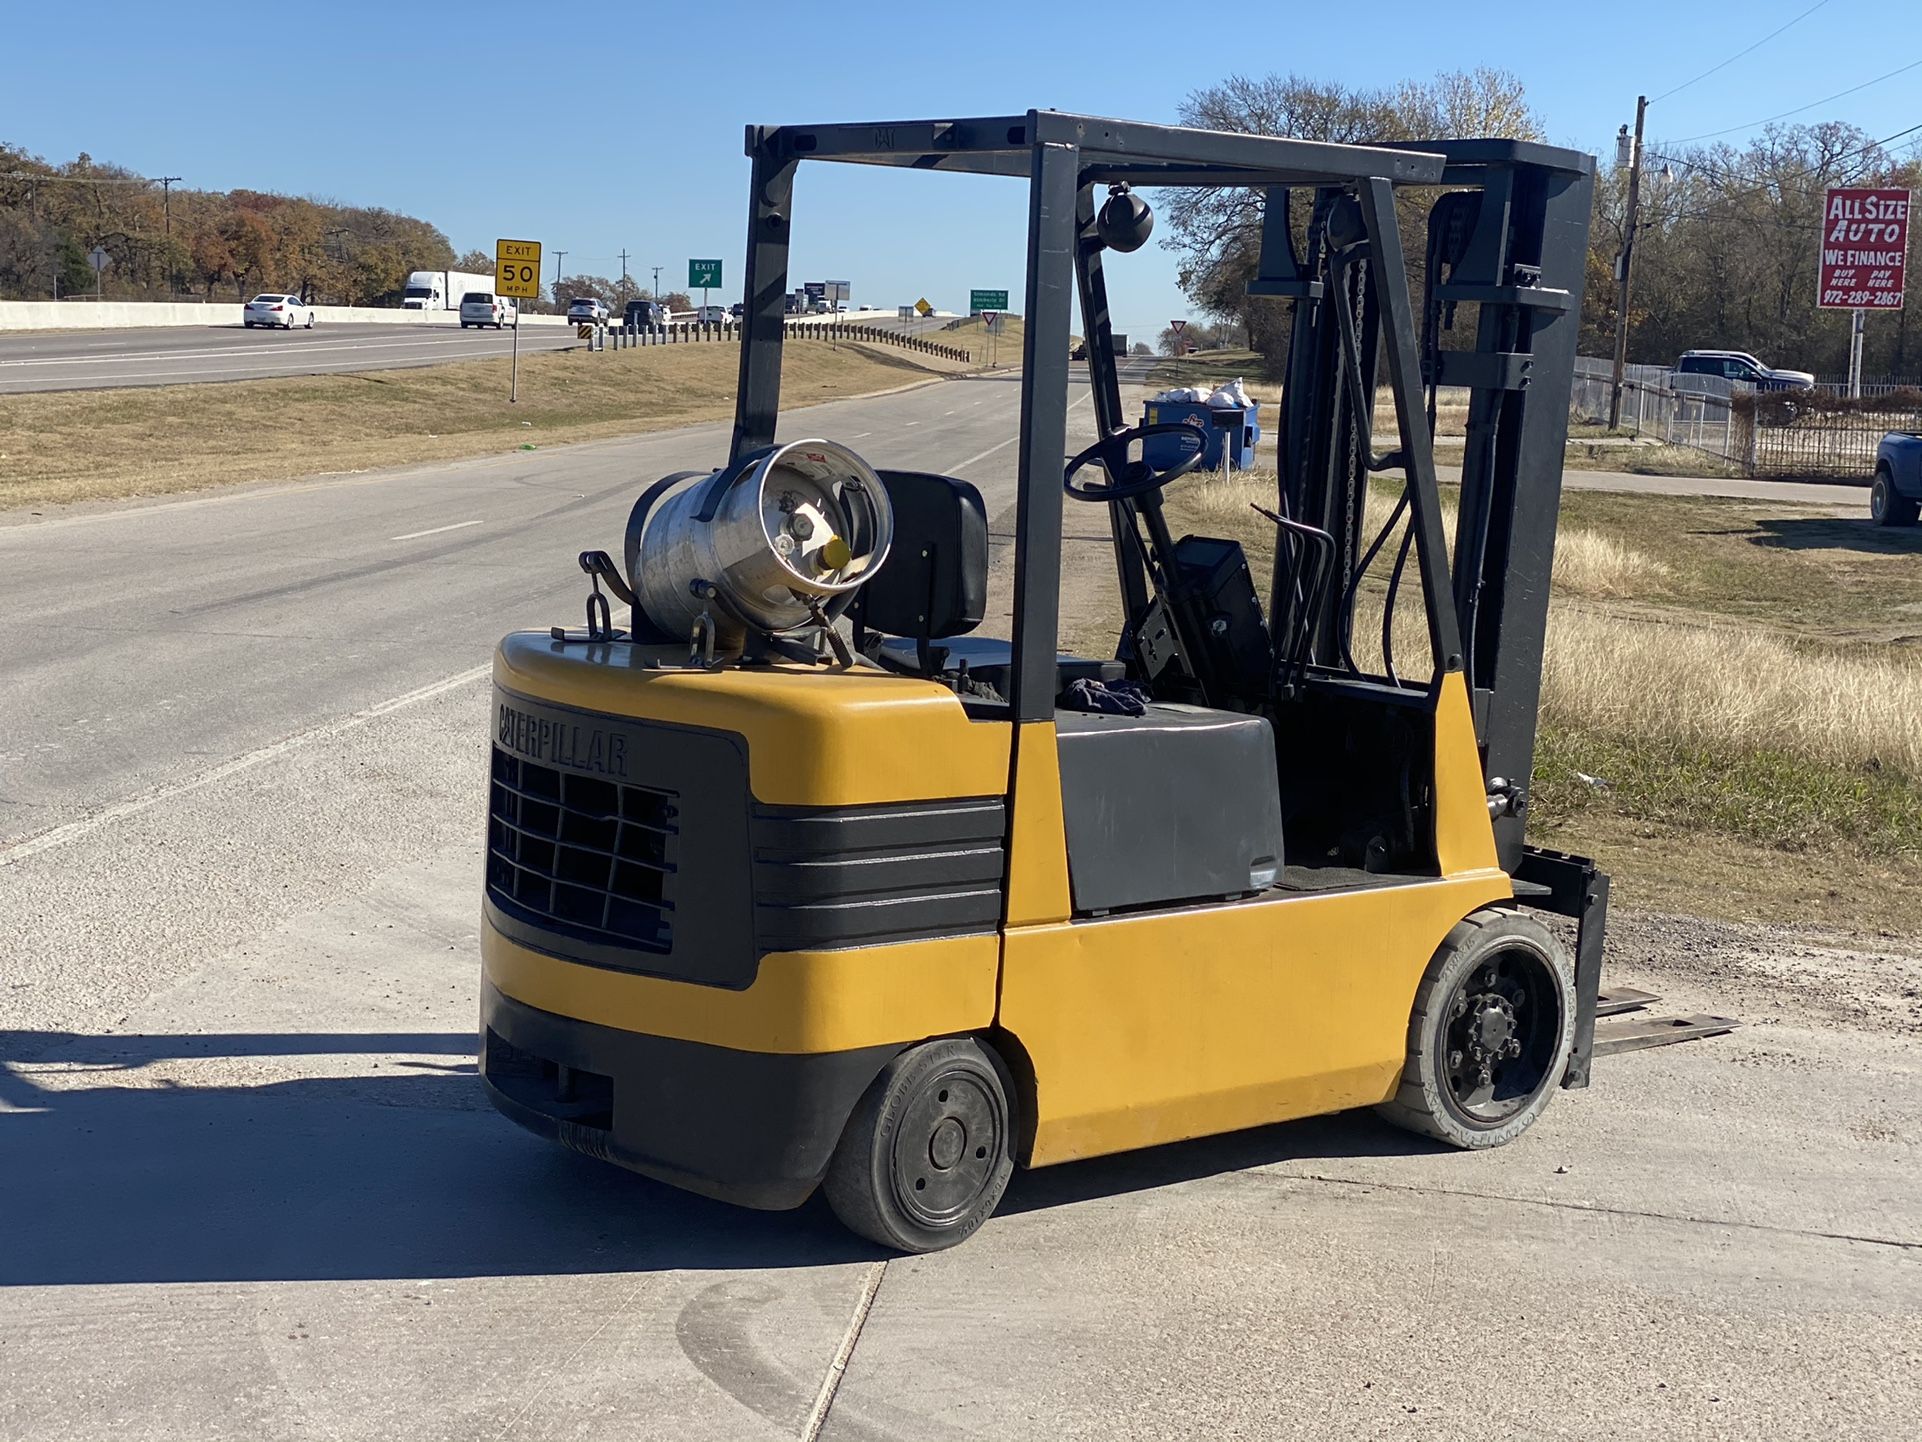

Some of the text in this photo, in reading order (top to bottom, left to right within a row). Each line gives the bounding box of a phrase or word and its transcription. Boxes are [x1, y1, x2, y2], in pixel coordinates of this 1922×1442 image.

[1829, 195, 1862, 219] ALL
[1829, 220, 1900, 242] AUTO
[506, 246, 531, 256] EXIT
[1825, 249, 1903, 266] WE FINANCE
[695, 263, 716, 271] EXIT
[503, 265, 533, 282] 50
[1833, 269, 1855, 278] BUY
[1871, 270, 1892, 279] PAY
[1830, 278, 1857, 287] HERE
[1867, 279, 1894, 288] HERE
[506, 285, 528, 293] MPH
[1824, 290, 1901, 305] 972-289-2867
[499, 703, 628, 777] CATERPILLAR
